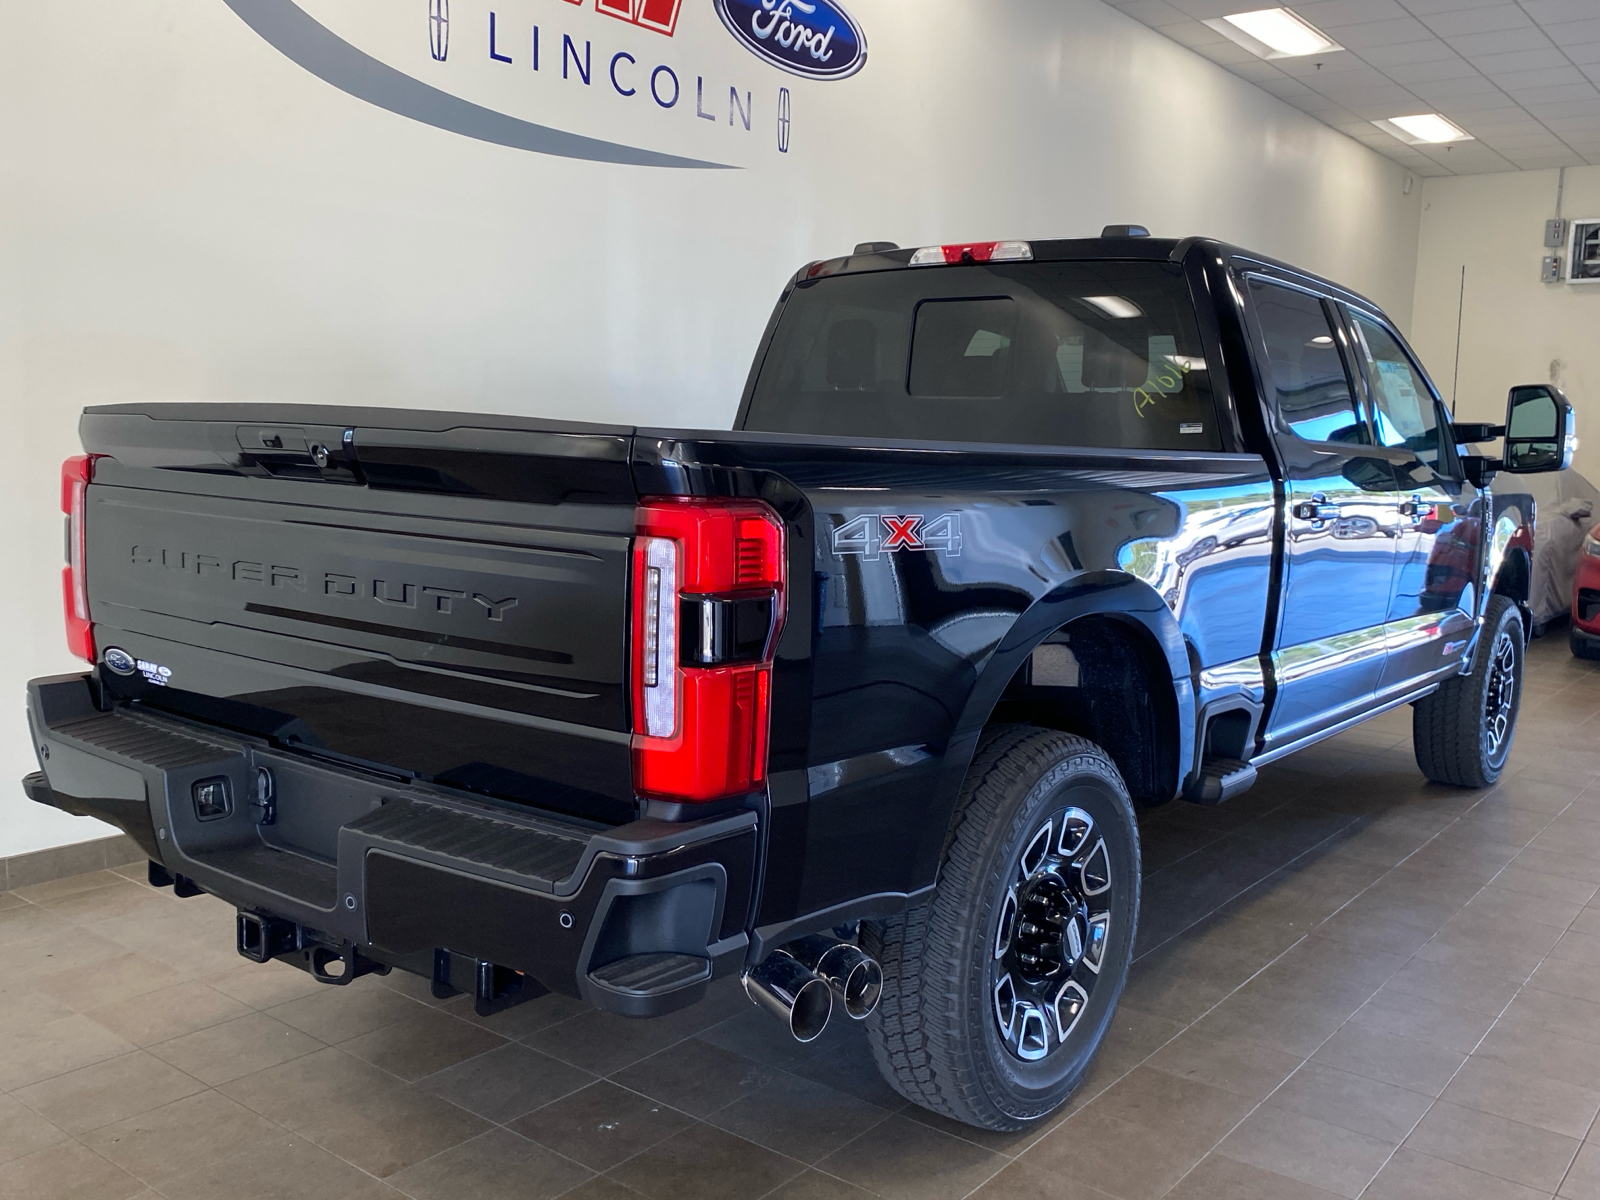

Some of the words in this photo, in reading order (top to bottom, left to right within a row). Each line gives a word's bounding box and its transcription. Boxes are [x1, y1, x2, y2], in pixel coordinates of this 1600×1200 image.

[752, 0, 836, 62] Ford
[489, 11, 752, 132] LINCOLN
[131, 545, 307, 592] SUPER
[324, 572, 519, 622] DUTY
[142, 670, 168, 683] LINCOLN
